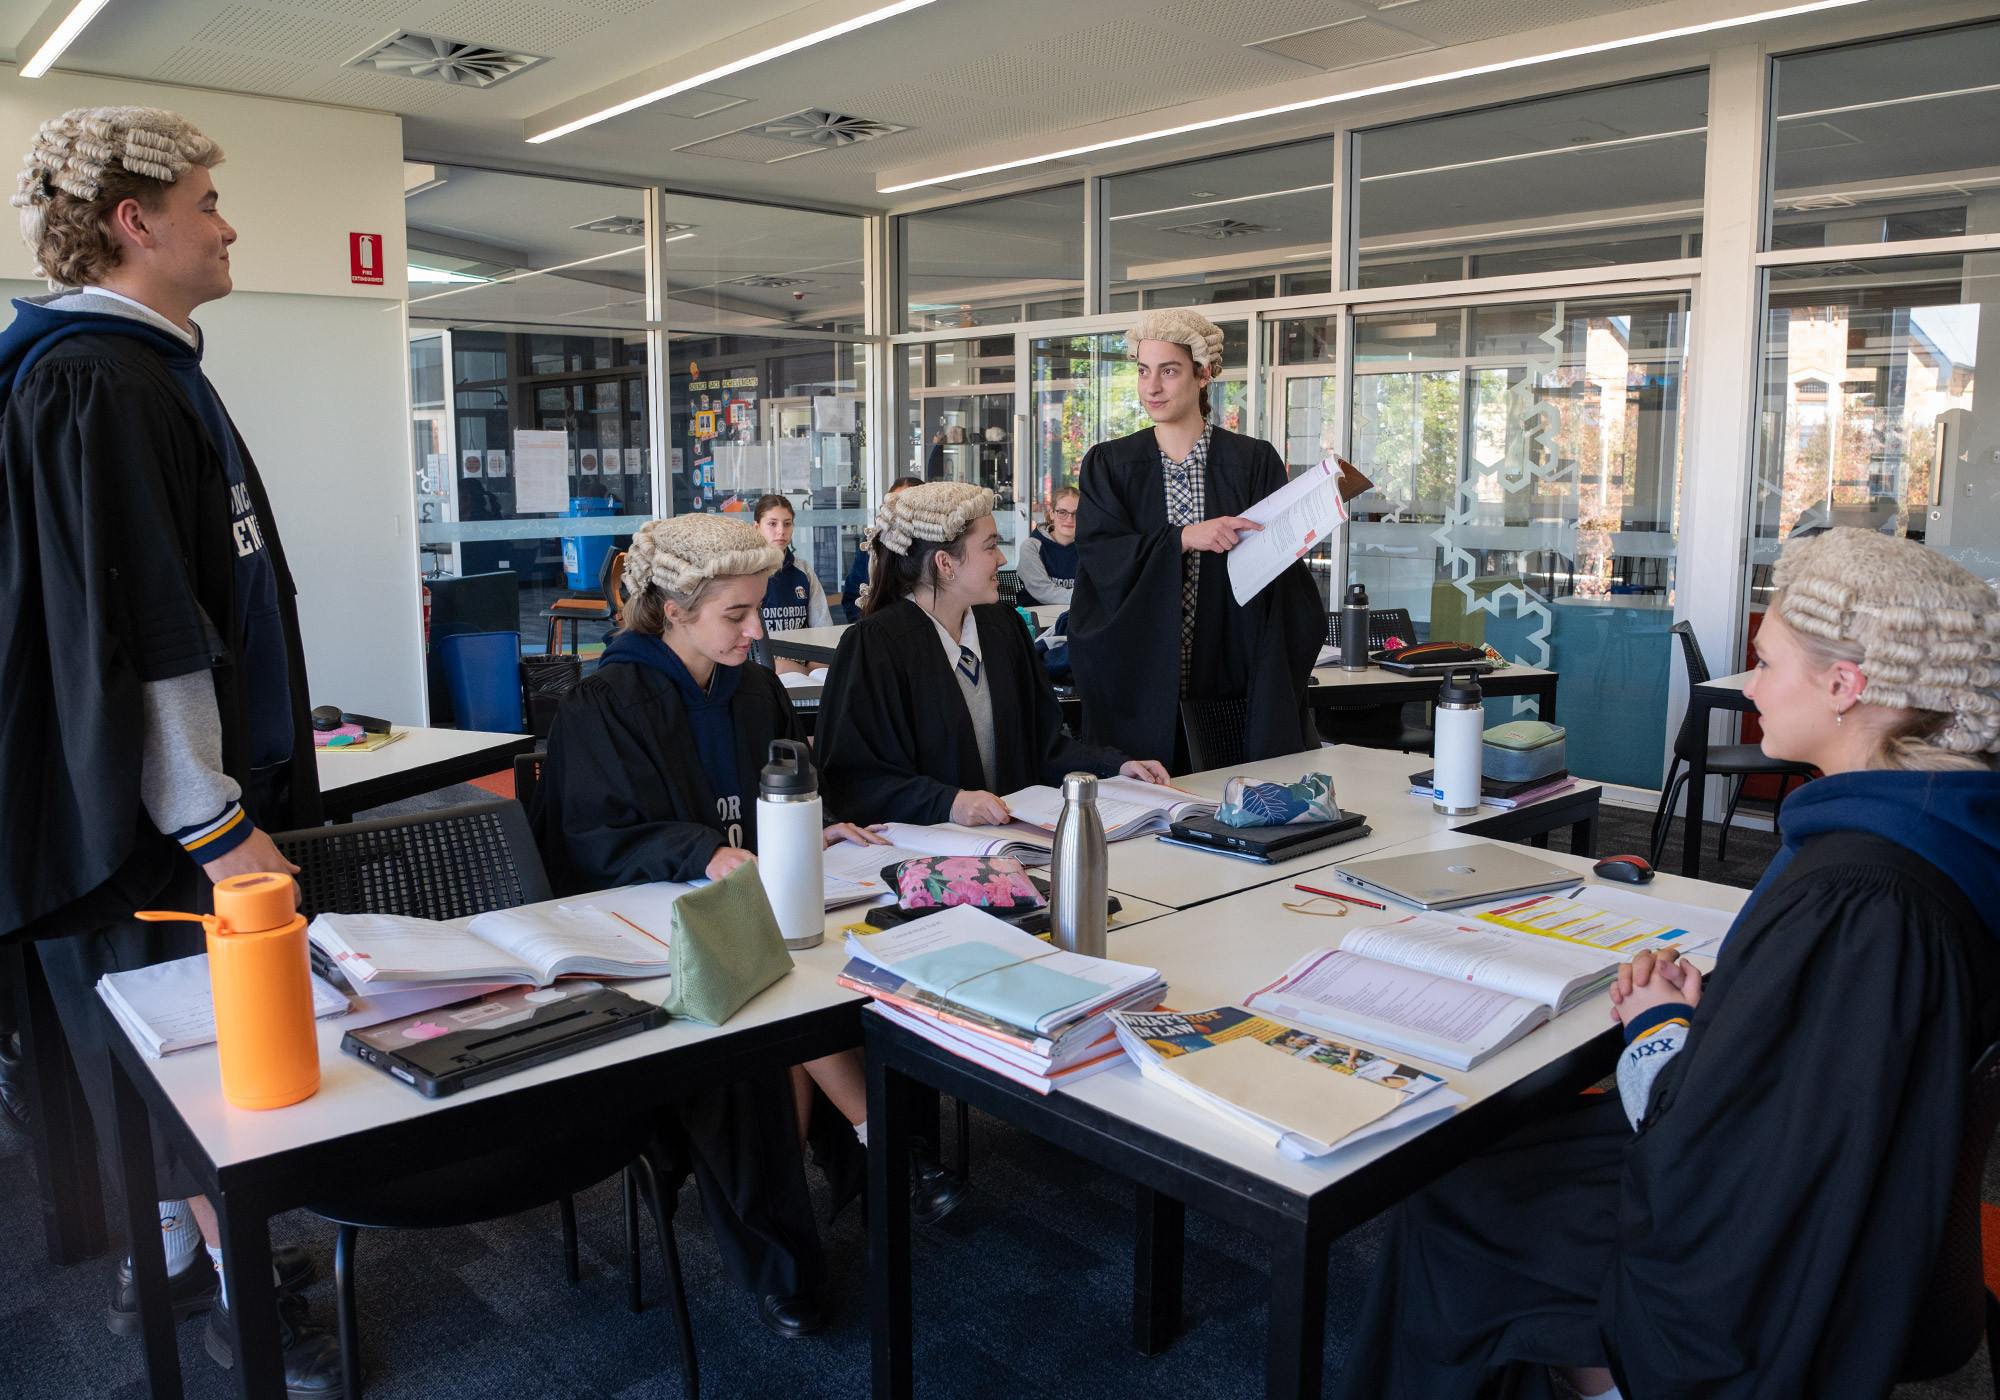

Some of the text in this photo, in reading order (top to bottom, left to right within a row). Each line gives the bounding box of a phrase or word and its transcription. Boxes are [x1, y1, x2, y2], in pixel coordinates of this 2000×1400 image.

[689, 382, 707, 391] SCIENCE
[722, 377, 758, 388] ACHIEVEMENTS
[761, 606, 807, 619] ONCORDIA
[1122, 1011, 1222, 1027] WHAT'S HOT
[1132, 1026, 1156, 1037] IN
[1152, 1024, 1196, 1037] LAW
